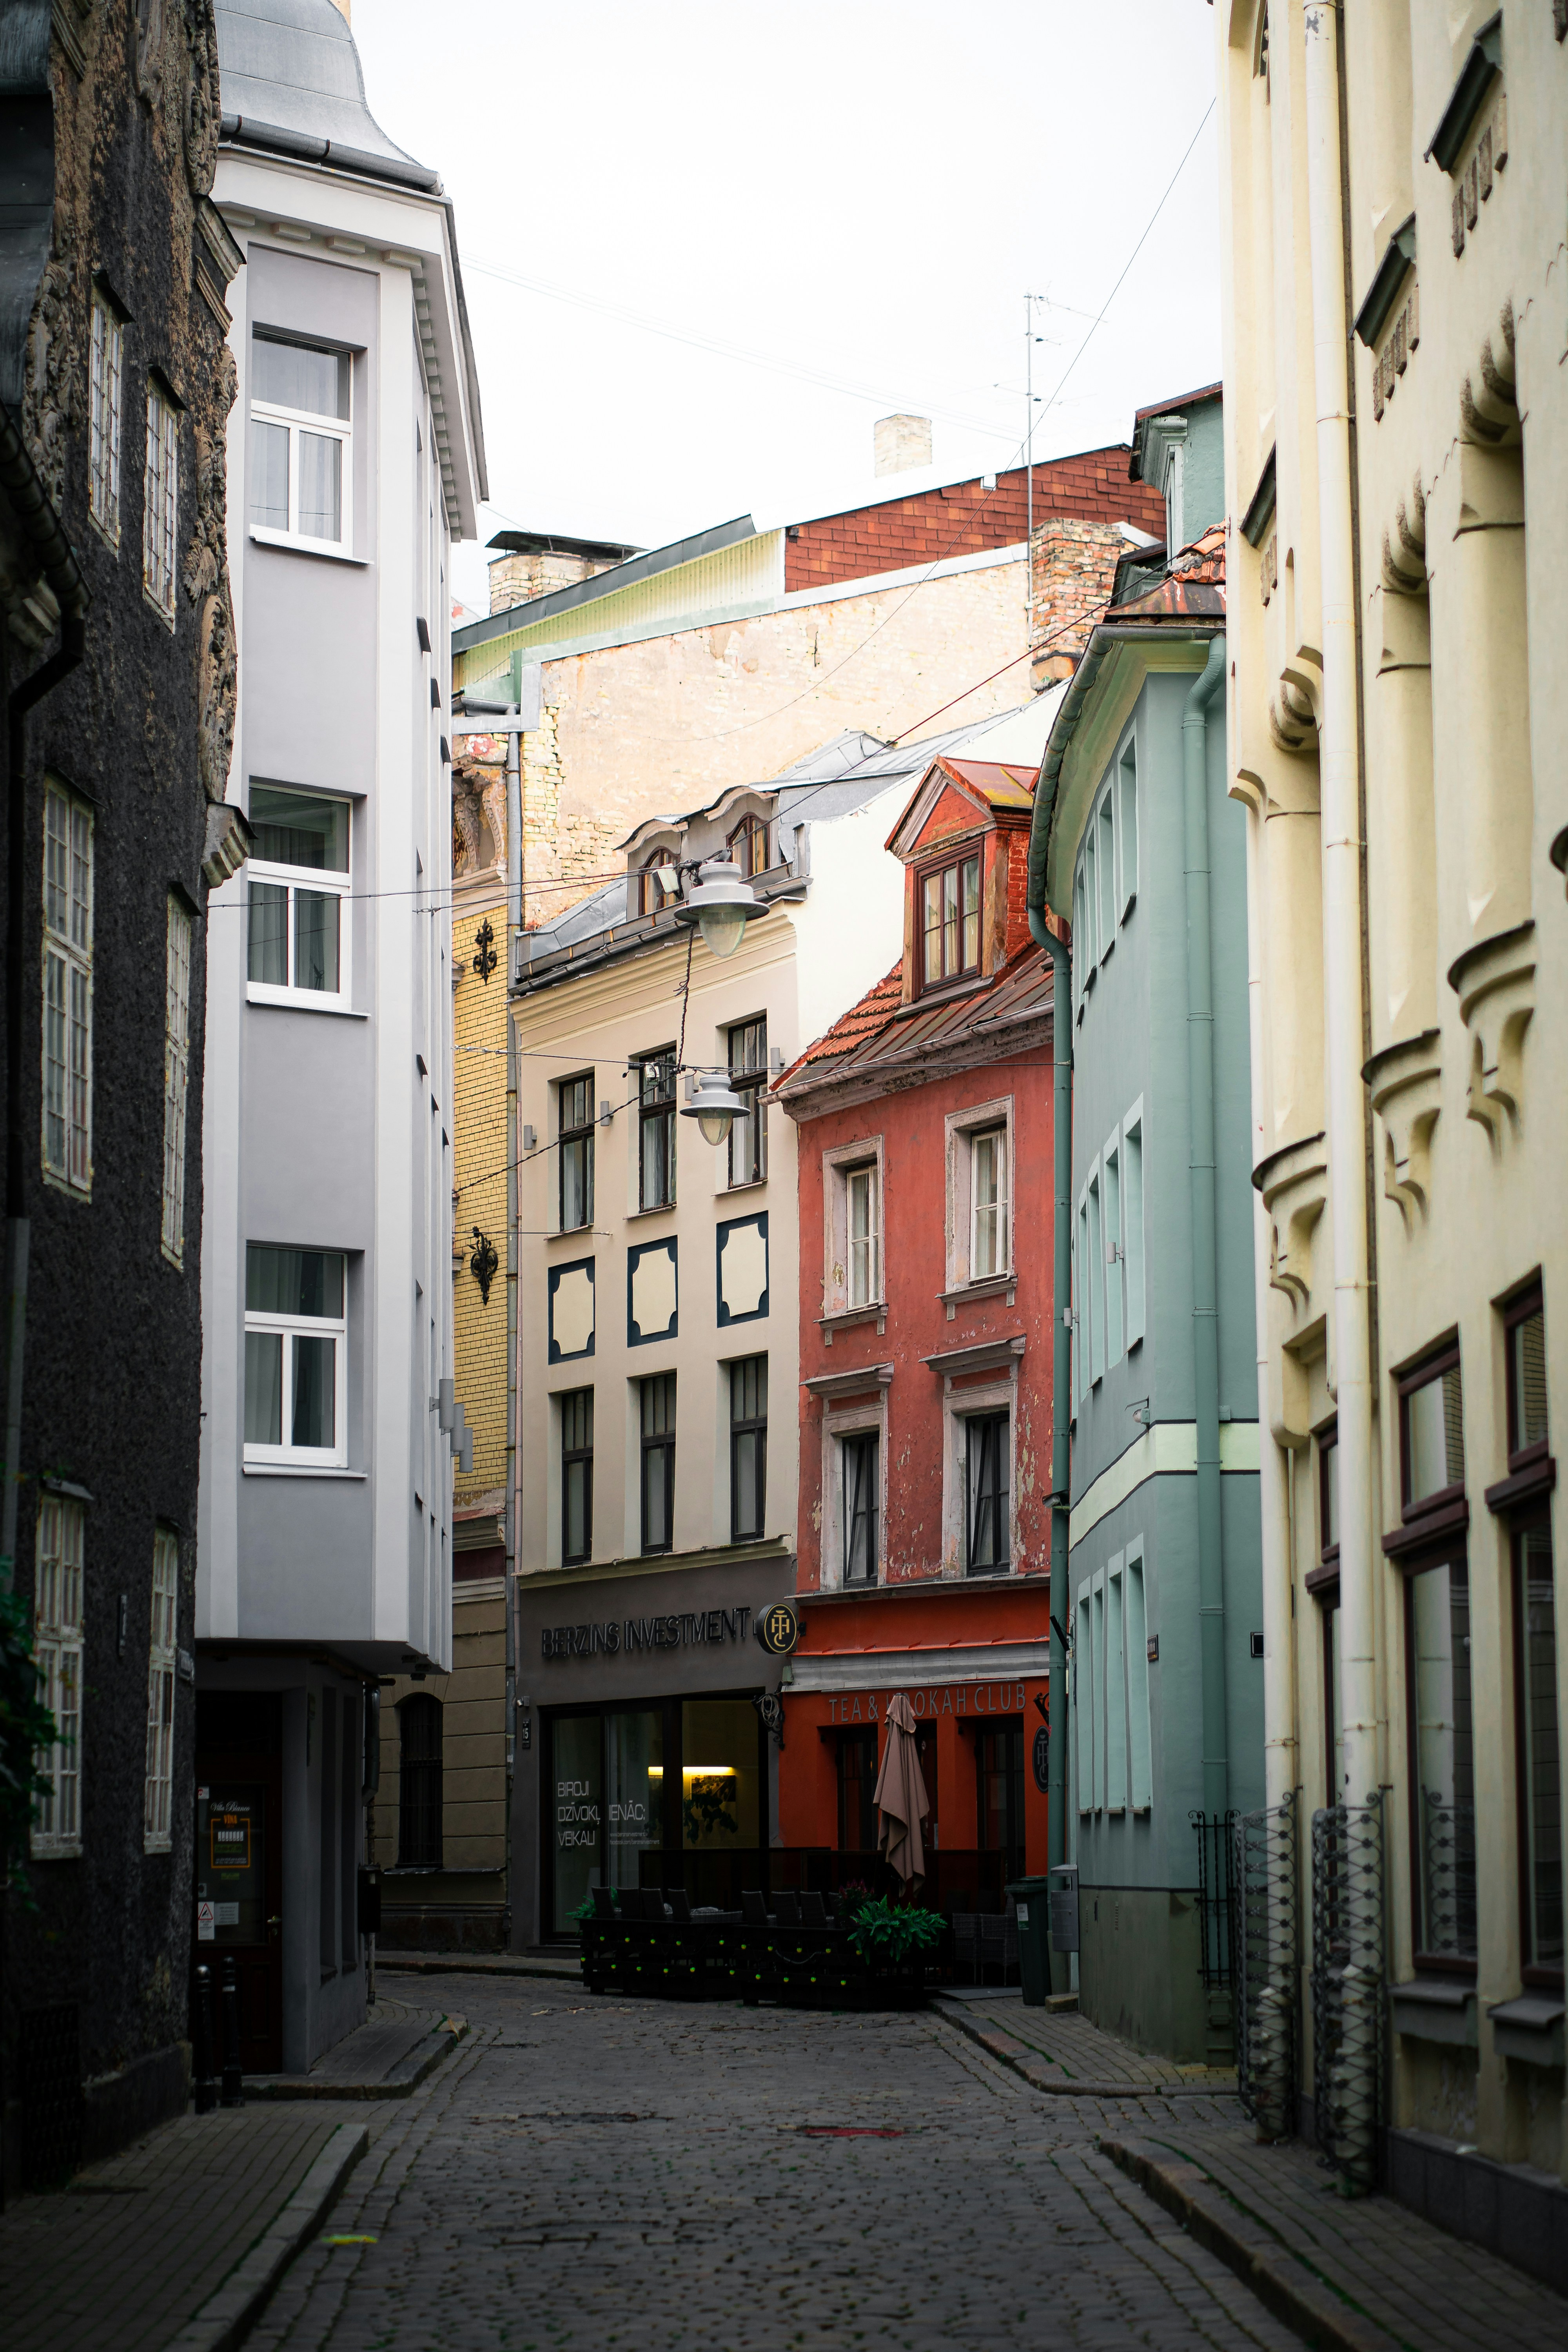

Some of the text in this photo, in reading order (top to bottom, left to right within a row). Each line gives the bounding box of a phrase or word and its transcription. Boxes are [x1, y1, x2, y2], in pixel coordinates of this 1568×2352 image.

[541, 1621, 620, 1657] BERZINS
[624, 1606, 750, 1650] INVESTMENT
[829, 1697, 862, 1723] TEA
[868, 1695, 879, 1720] &
[975, 1684, 1026, 1713] CLUB
[523, 1728, 528, 1739] 15
[558, 1781, 589, 1797] BIROJI
[211, 1801, 225, 1812] Villa
[609, 1800, 645, 1821] IENĀC:
[558, 1830, 595, 1846] VEIKALI
